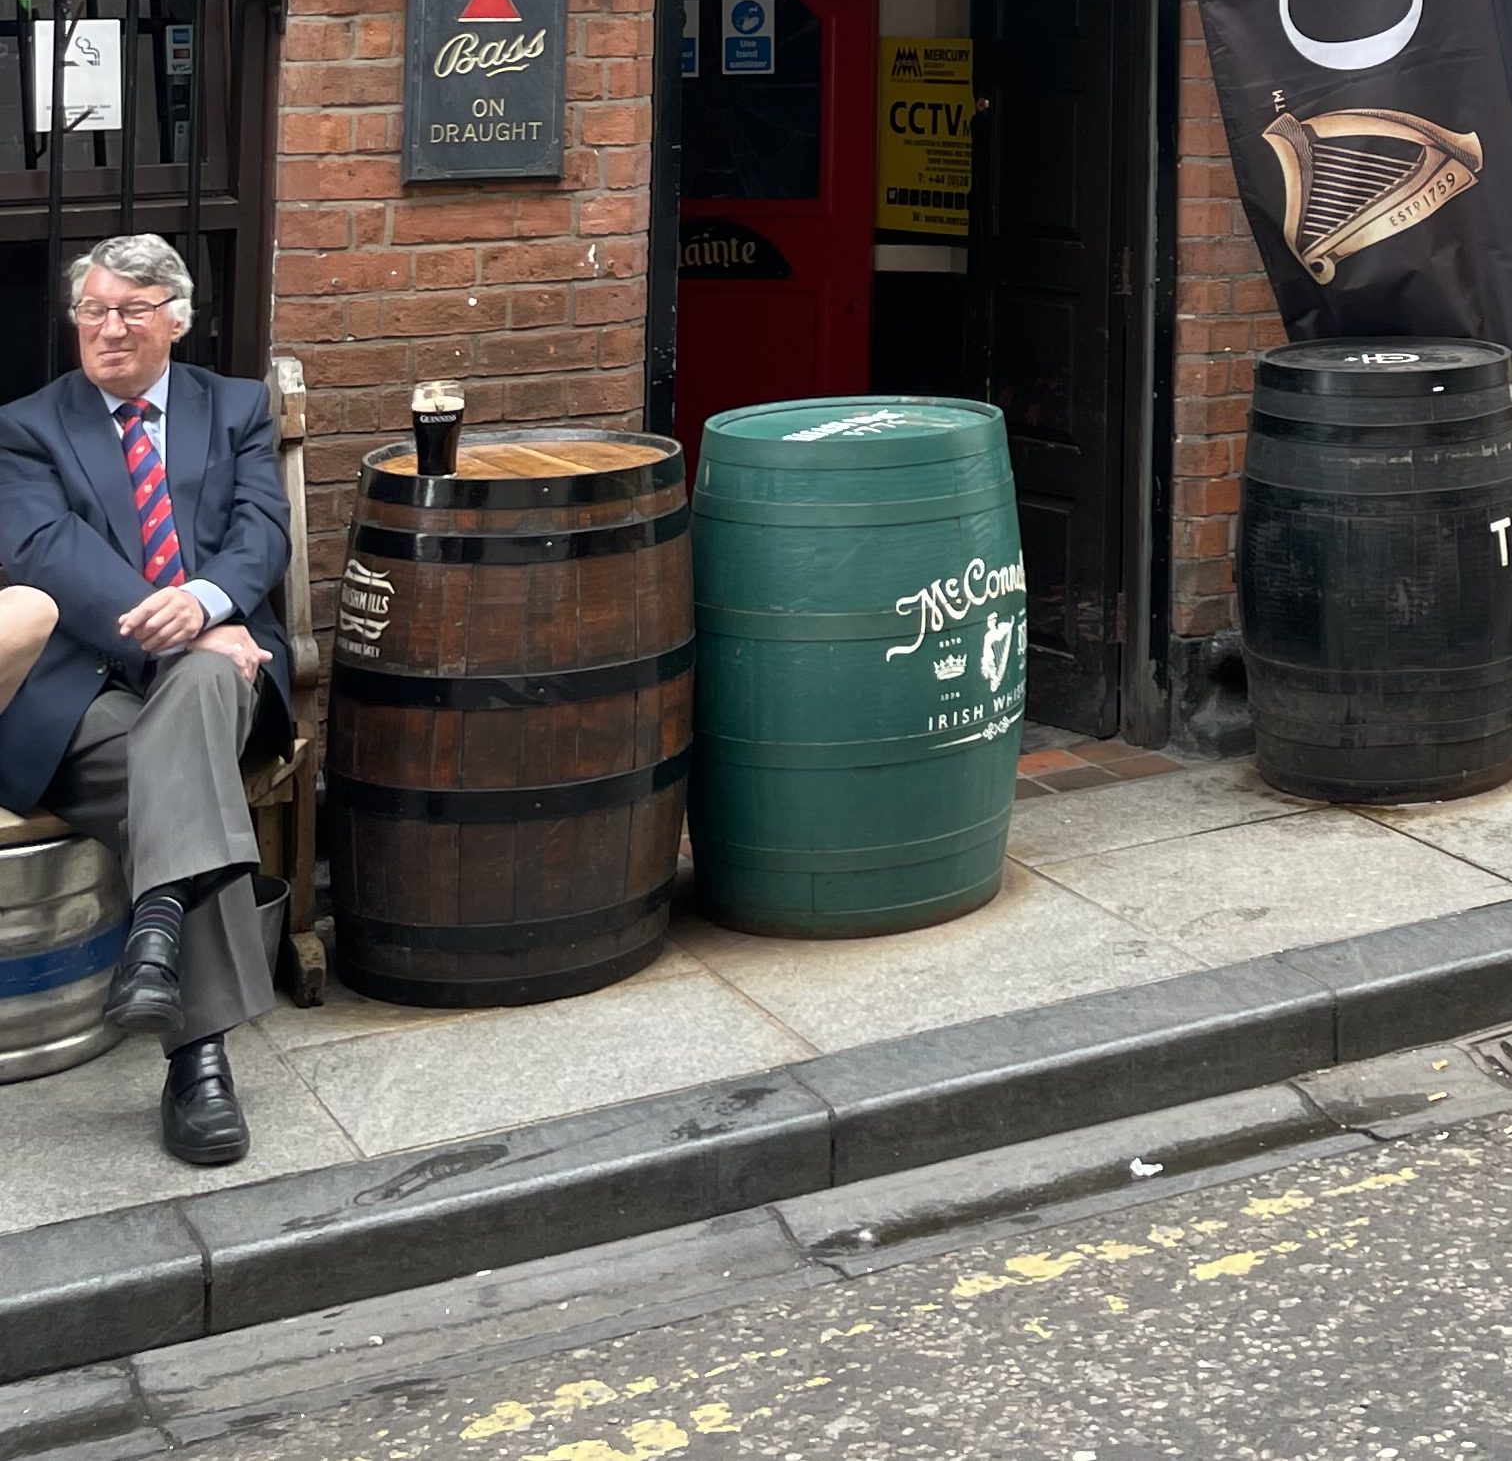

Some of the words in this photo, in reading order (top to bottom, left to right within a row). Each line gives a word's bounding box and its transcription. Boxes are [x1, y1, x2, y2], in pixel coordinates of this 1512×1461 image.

[434, 28, 547, 79] Bass
[924, 49, 970, 62] MERCURY
[472, 98, 505, 117] ON
[890, 101, 963, 136] CCTV
[430, 122, 543, 144] DRAUGHT
[1422, 172, 1457, 208] 1759
[928, 704, 984, 731] IRISH
